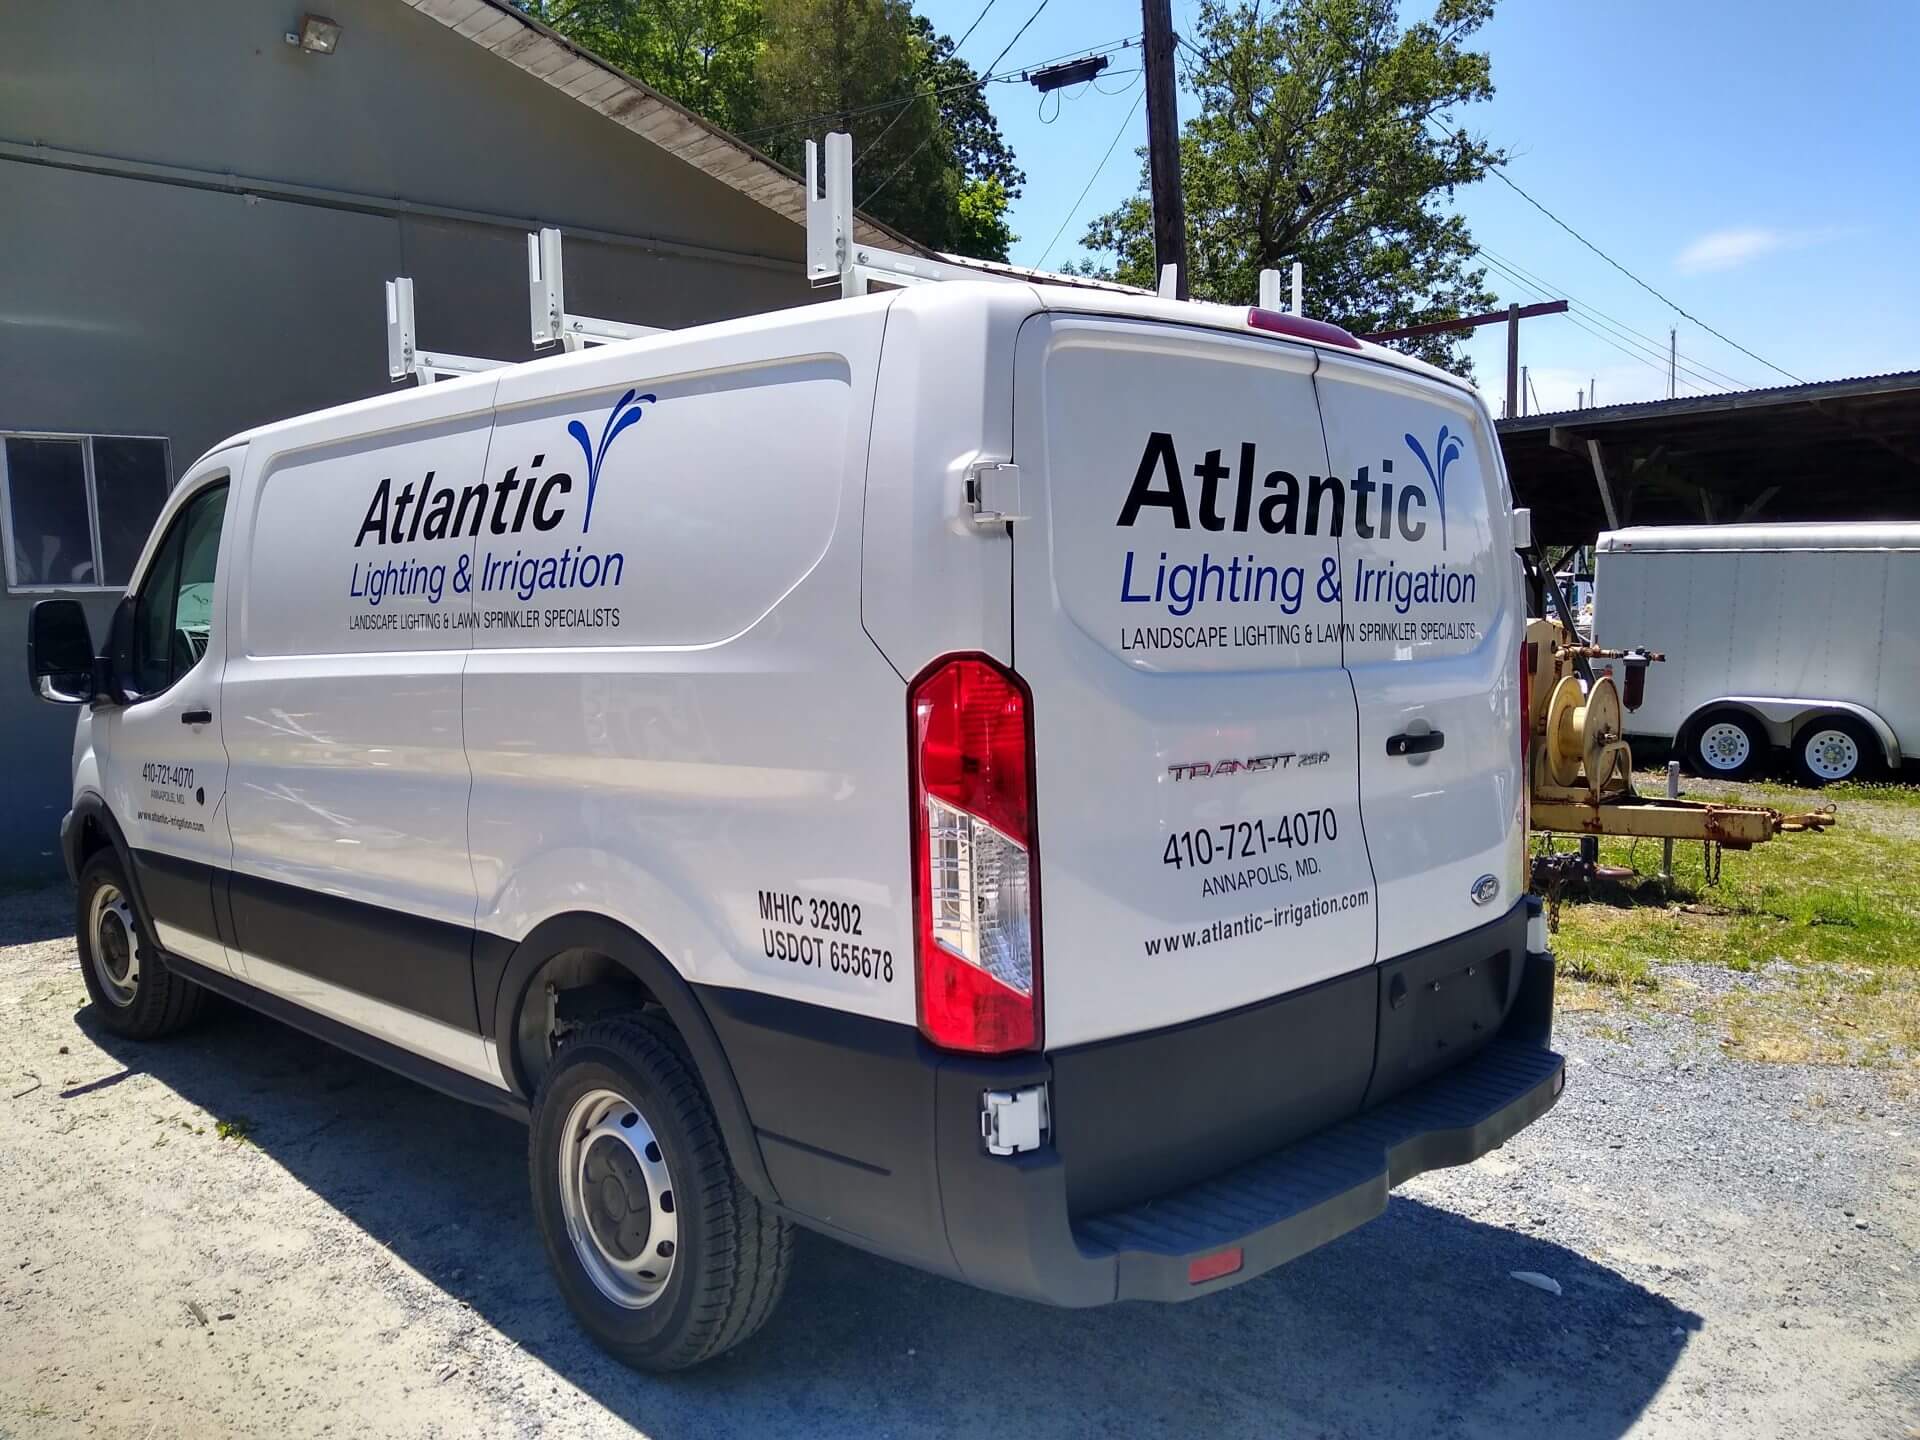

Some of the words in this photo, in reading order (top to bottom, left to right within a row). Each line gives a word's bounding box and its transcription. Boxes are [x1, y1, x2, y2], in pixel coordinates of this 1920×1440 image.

[354, 454, 572, 547] Atlantic
[1116, 431, 1427, 542] Atlantic
[350, 555, 446, 606] Lighting
[453, 554, 472, 593] &
[481, 546, 624, 601] Irrigation
[1120, 551, 1304, 616] Lighting
[1316, 556, 1341, 602] &
[1355, 558, 1475, 614] Irrigation
[349, 613, 398, 630] LANDSCAPE
[400, 613, 441, 630] LIGHTING
[443, 613, 449, 629] &
[452, 612, 480, 629] LAWN
[483, 610, 540, 628] SPRINKLER
[544, 608, 620, 628] SPECIALISTS
[1121, 625, 1228, 650] LANDSCAPE
[1234, 624, 1300, 647] LIGHTING
[1305, 625, 1312, 643] &
[1317, 623, 1354, 643] LAWN
[1359, 622, 1417, 642] SPRINKLER
[1421, 622, 1475, 641] SPECIALISTS
[142, 761, 194, 789] 410-721-4070
[1168, 752, 1297, 782] TRANSIT
[1163, 807, 1337, 870] 410-721-4070
[1202, 862, 1293, 898] ANNAPOLIS,
[1296, 857, 1321, 877] MD.
[758, 890, 804, 926] MHIC
[809, 898, 863, 936] 32902
[1145, 890, 1369, 956] www.atlantic-irrigation.com
[762, 928, 824, 969] USDOT
[830, 941, 894, 983] 655678
